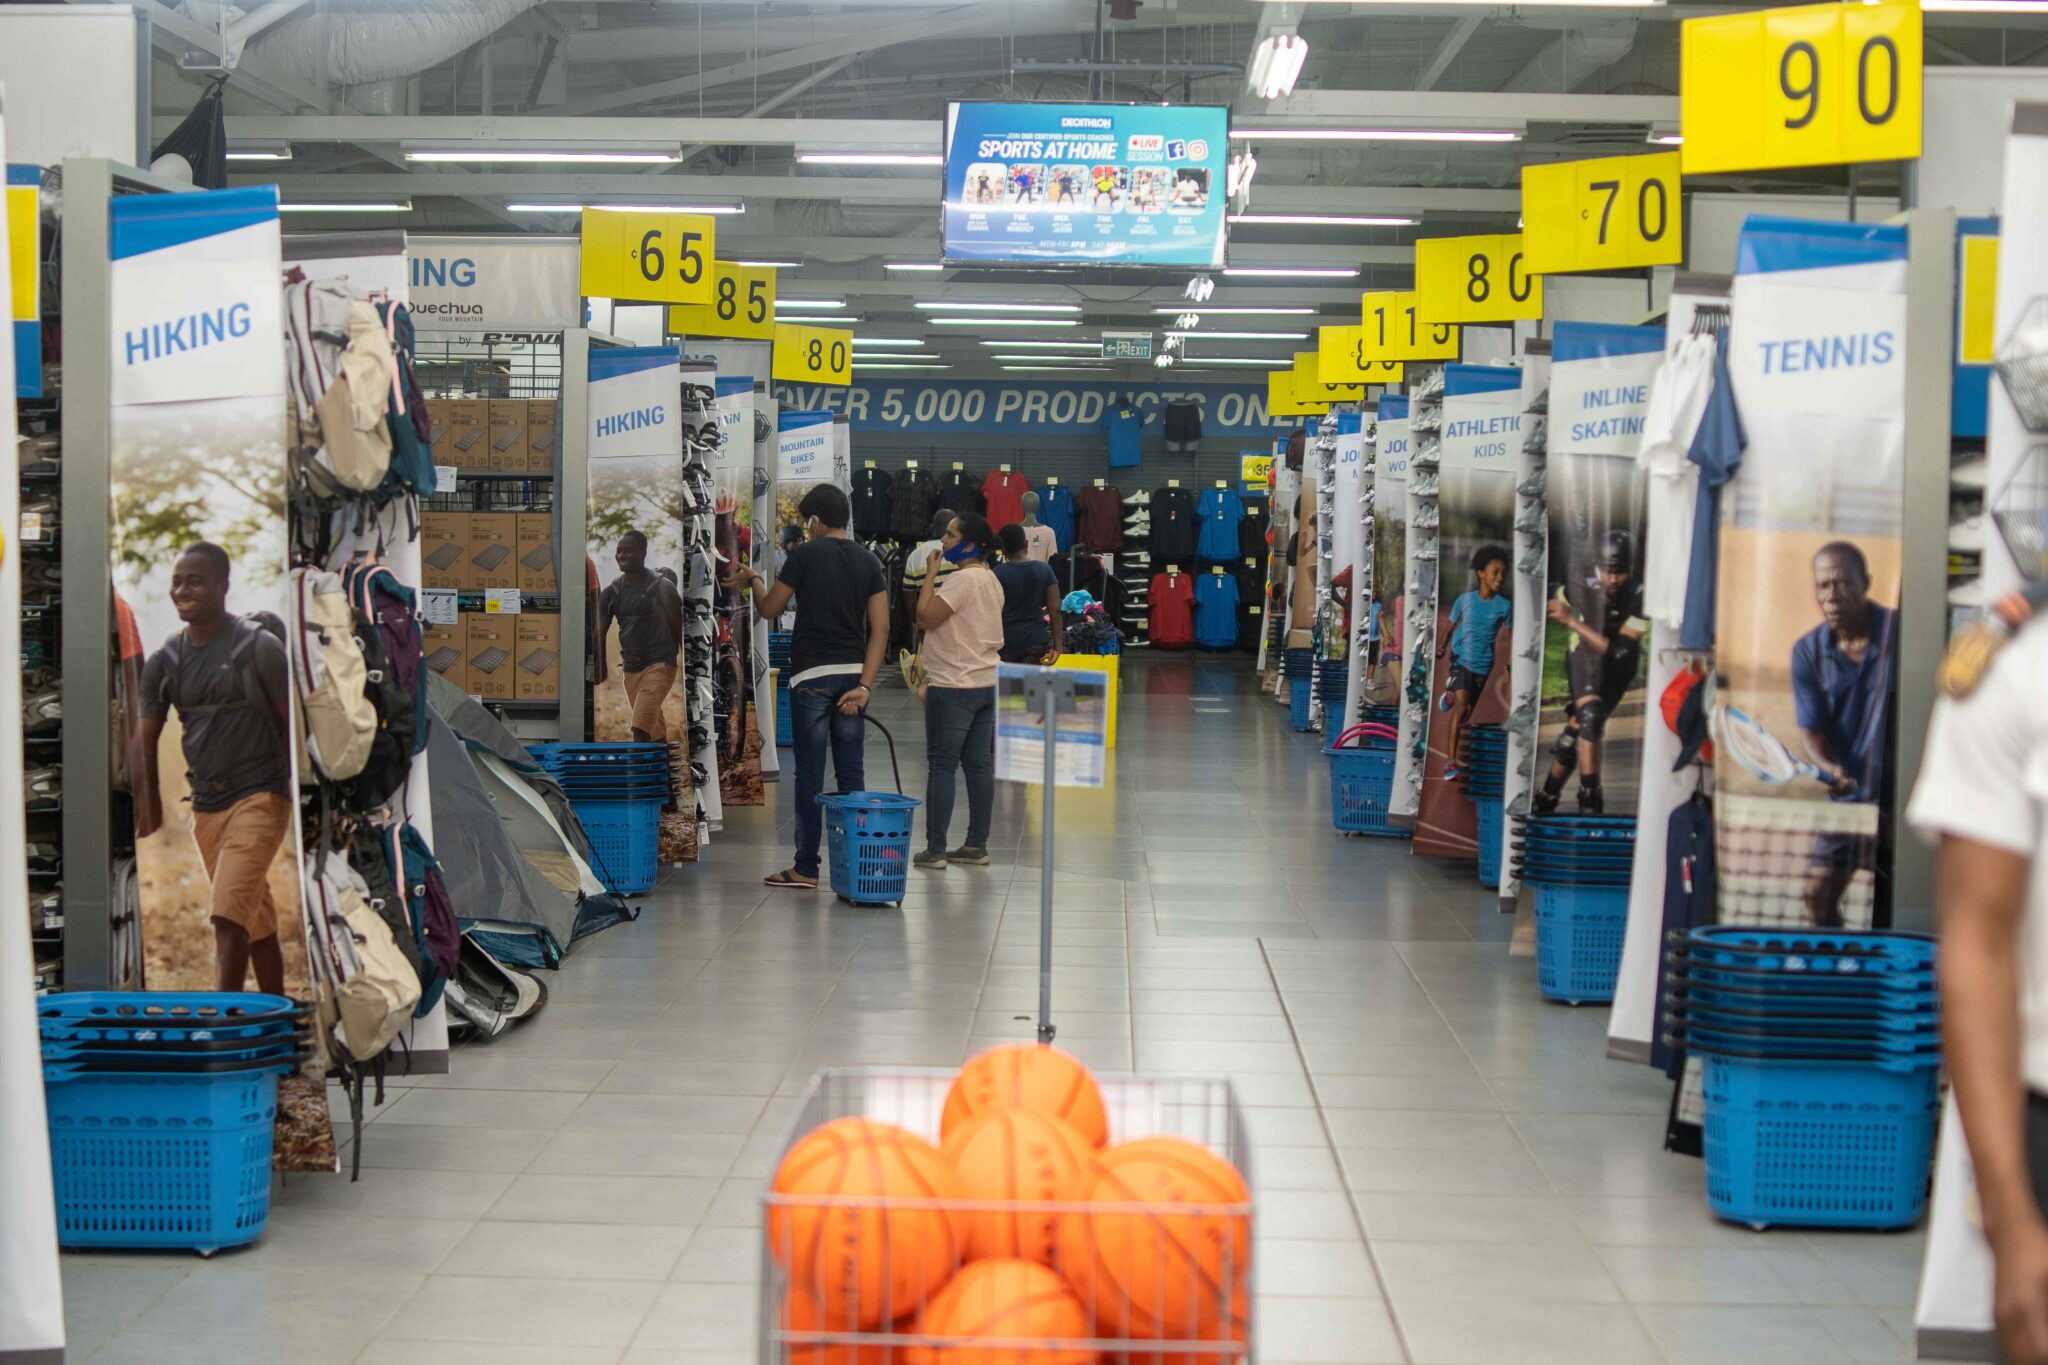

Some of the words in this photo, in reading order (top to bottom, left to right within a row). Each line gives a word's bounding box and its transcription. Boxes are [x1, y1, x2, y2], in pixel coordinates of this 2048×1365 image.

[1779, 35, 1899, 129] 90
[1061, 117, 1111, 129] DECATHLON
[978, 140, 1043, 158] SPORTS
[1043, 141, 1068, 159] AT
[1067, 141, 1118, 160] HOME
[1140, 138, 1161, 148] LIVE
[1127, 151, 1163, 162] SESSION
[408, 258, 476, 287] ING
[717, 276, 767, 324] 85
[124, 302, 252, 365] HIKING
[459, 336, 471, 347] by
[1131, 345, 1148, 357] EXIT
[1760, 331, 1895, 374] TENNIS
[1583, 384, 1647, 409] INLINE
[880, 388, 986, 428] 5,000
[596, 406, 665, 438] HIKING
[780, 437, 824, 453] MOUNTAIN
[1474, 443, 1506, 458] KIDS
[790, 452, 815, 465] BIKES
[1341, 450, 1360, 463] JO
[795, 465, 812, 475] KIDS
